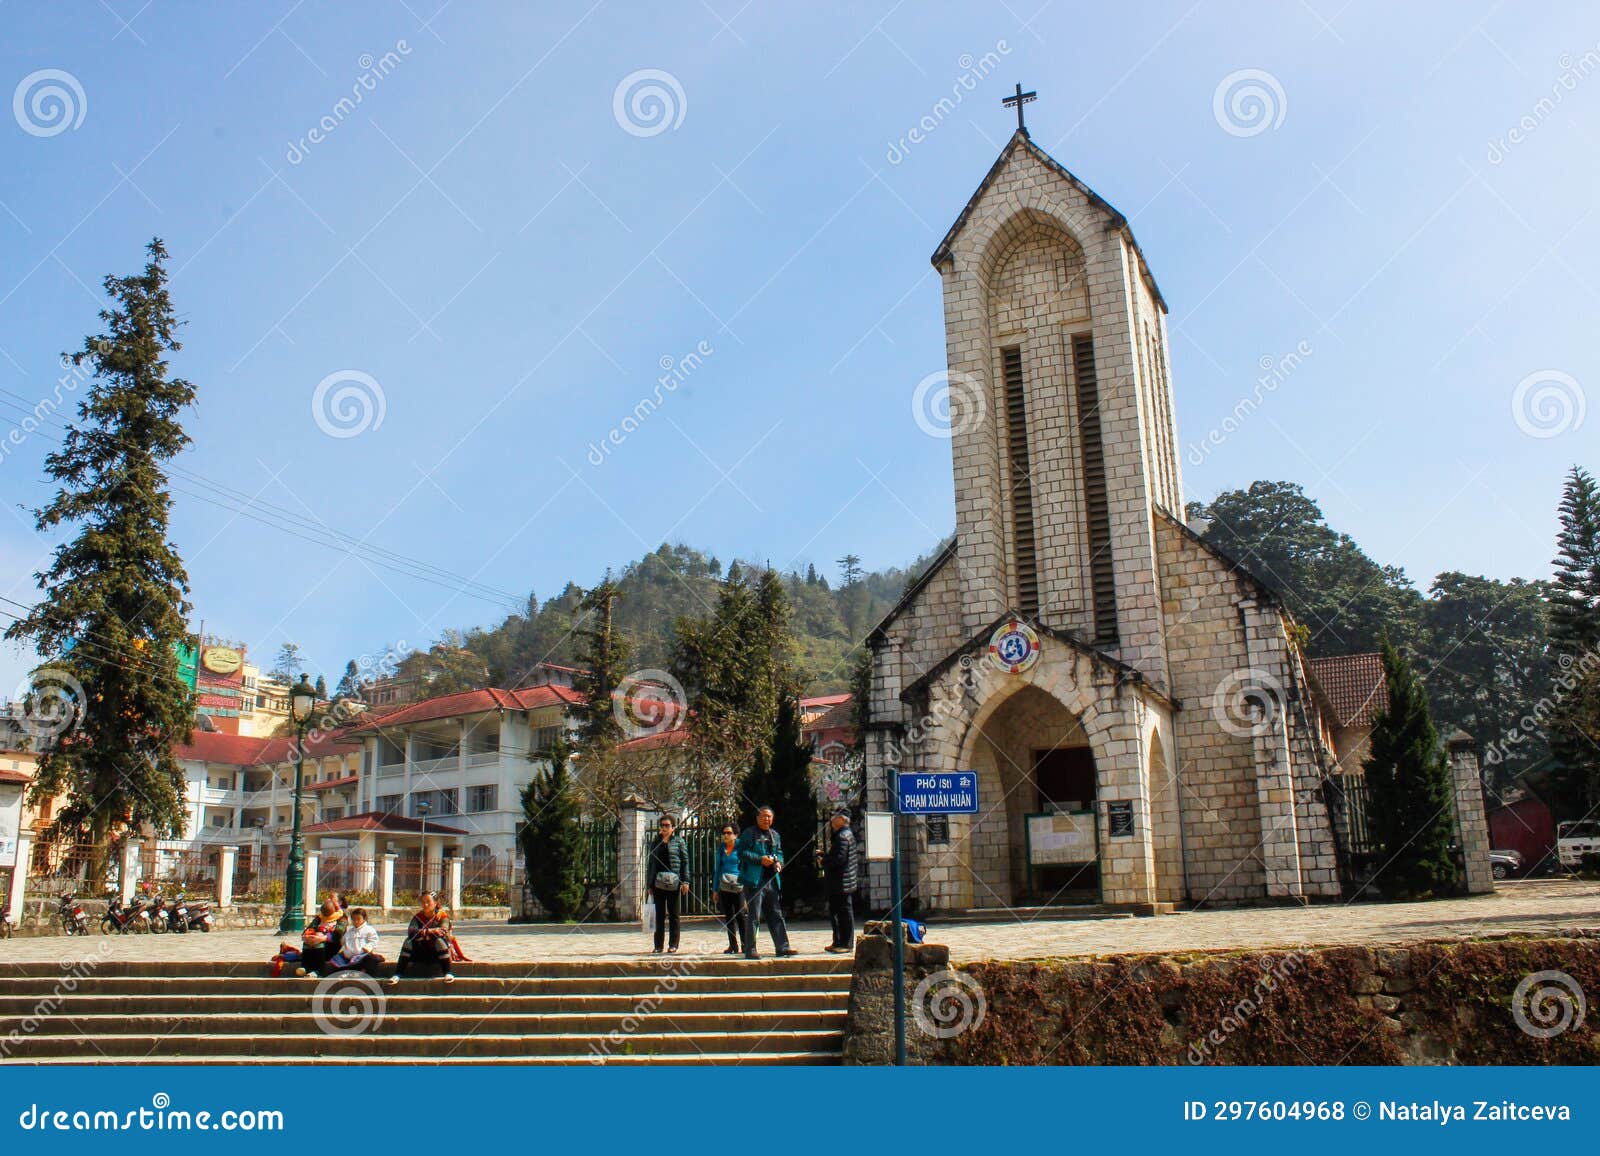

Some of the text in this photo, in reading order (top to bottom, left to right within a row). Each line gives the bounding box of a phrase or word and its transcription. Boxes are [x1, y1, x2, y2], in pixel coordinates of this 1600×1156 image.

[916, 775, 936, 789] PHỐ
[905, 790, 971, 810] PHẠM XUÂN HUÂN
